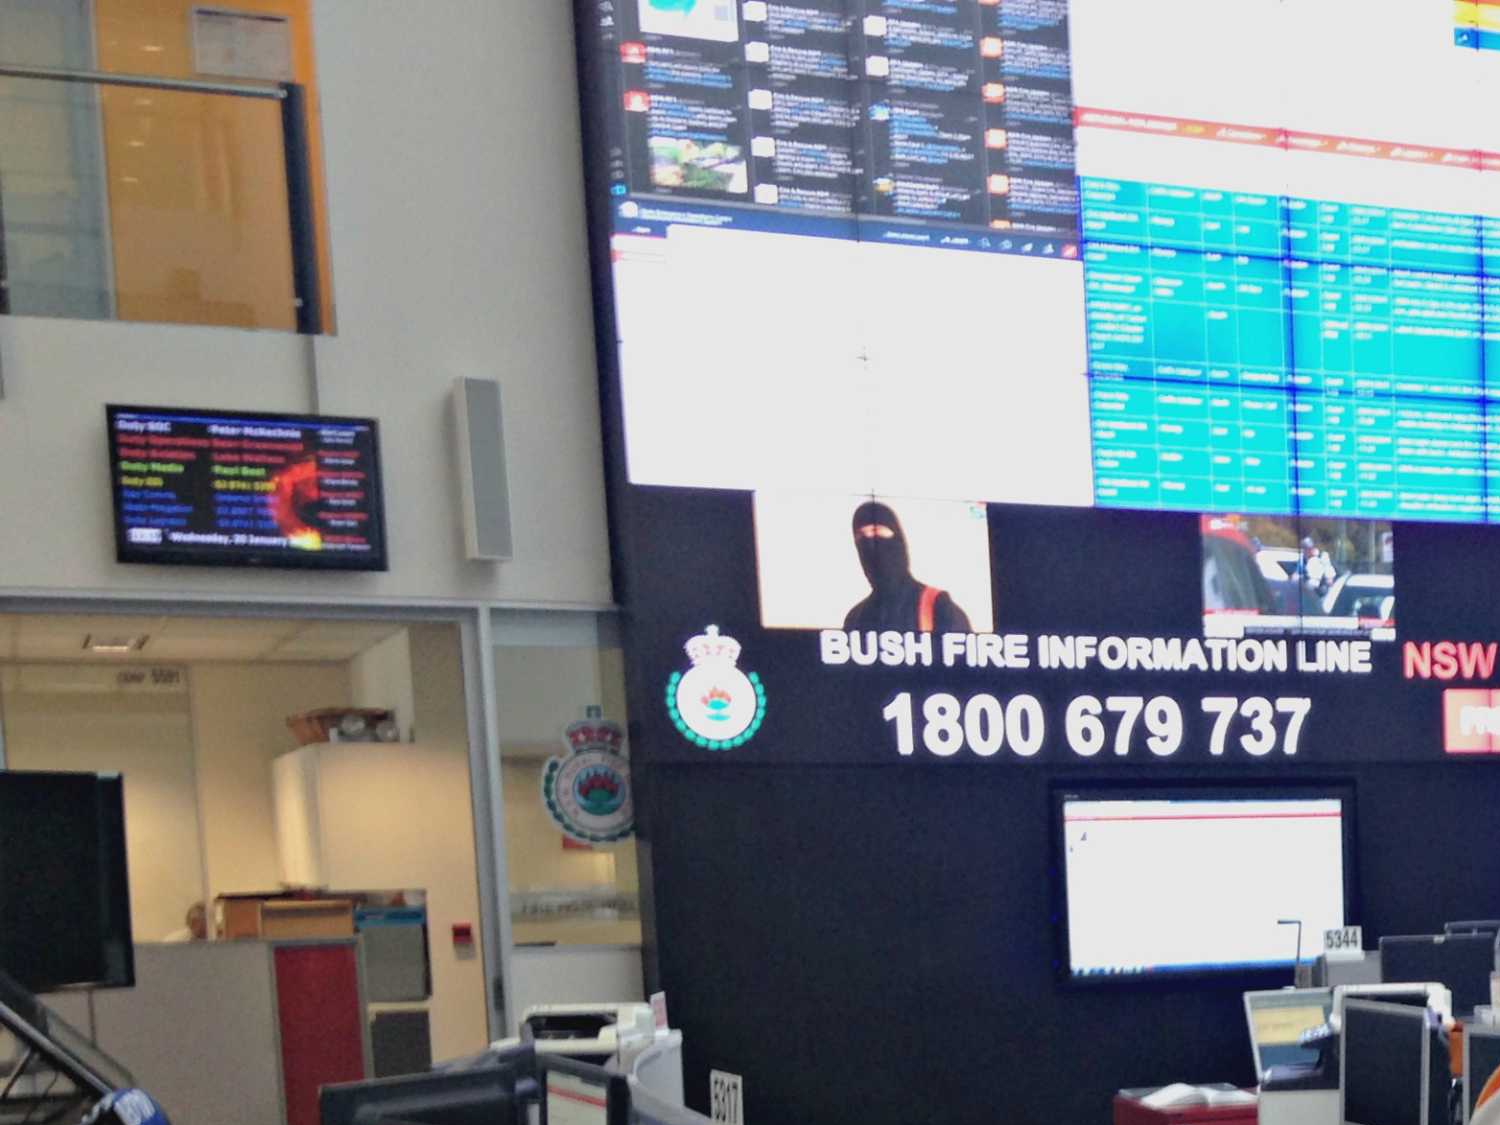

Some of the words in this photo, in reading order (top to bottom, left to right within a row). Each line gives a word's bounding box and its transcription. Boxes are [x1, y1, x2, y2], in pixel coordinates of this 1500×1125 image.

[820, 630, 932, 666] BUSH
[943, 633, 1030, 669] FIRE
[1038, 635, 1288, 672] INFORMATION
[1297, 640, 1372, 673] LINE
[1403, 642, 1497, 680] NSW
[882, 692, 1046, 757] 1800
[1064, 695, 1184, 757] 679
[1201, 696, 1312, 756] 737
[1325, 929, 1359, 950] 5344
